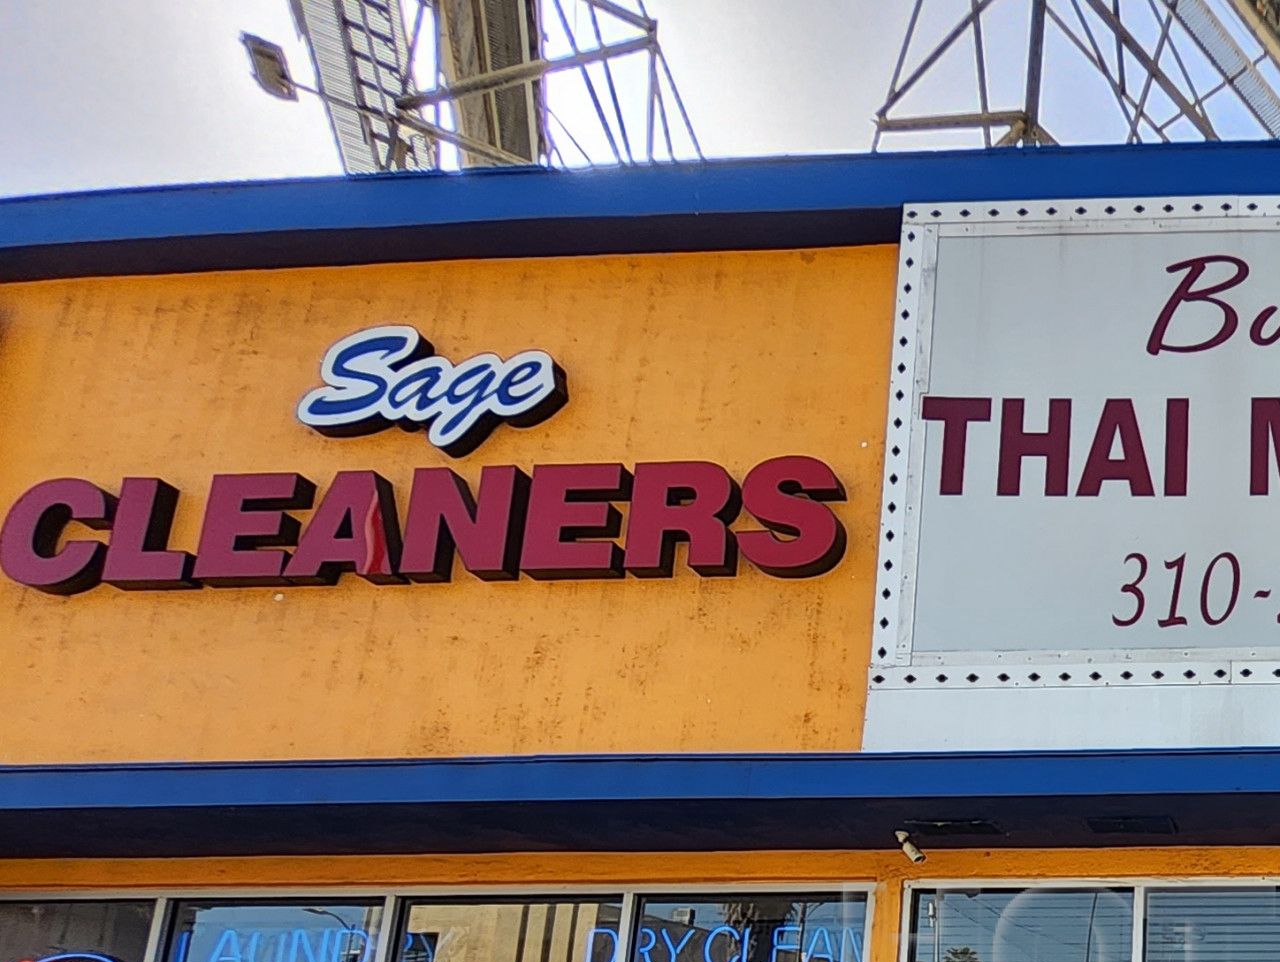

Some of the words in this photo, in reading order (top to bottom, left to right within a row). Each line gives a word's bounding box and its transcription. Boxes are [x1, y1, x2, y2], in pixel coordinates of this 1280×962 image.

[297, 325, 560, 450] Sage
[921, 394, 1190, 498] THAI
[0, 455, 847, 594] CLEANERS
